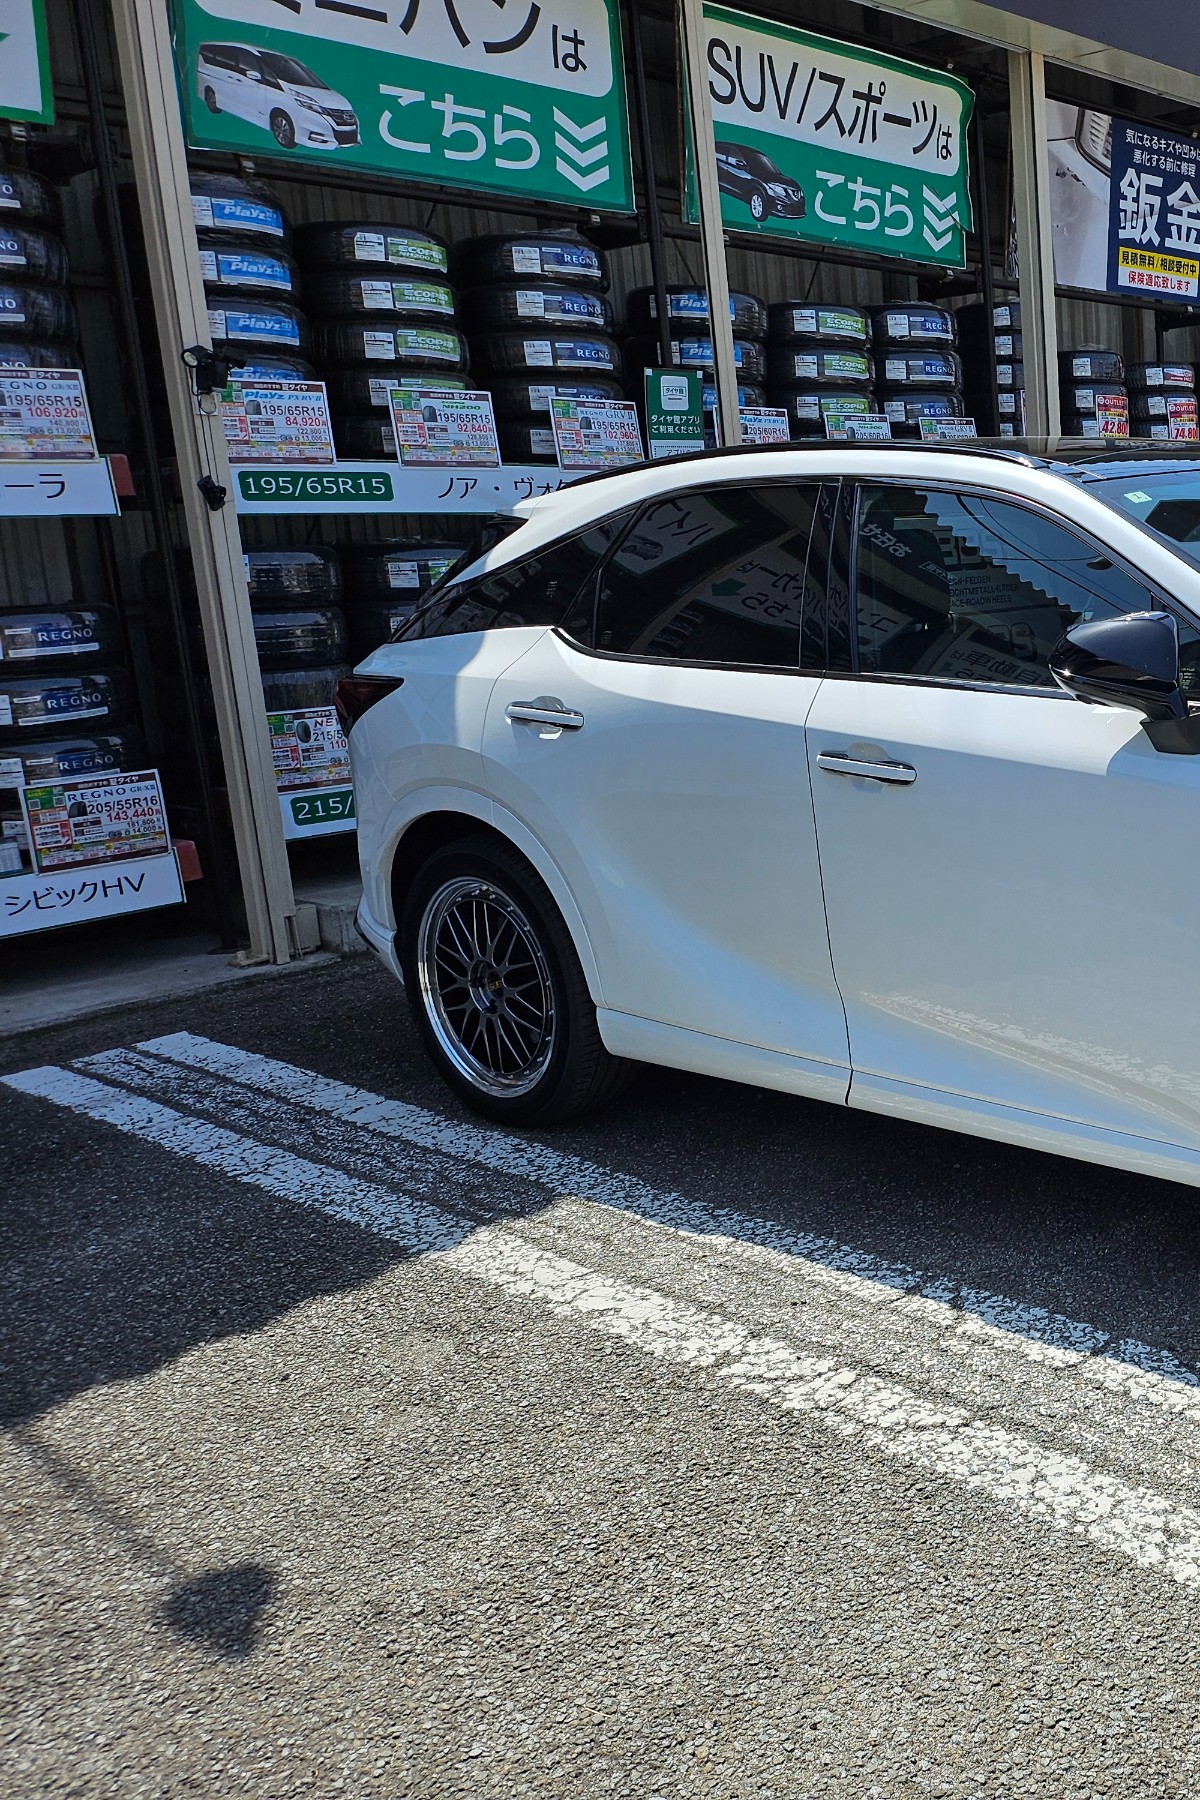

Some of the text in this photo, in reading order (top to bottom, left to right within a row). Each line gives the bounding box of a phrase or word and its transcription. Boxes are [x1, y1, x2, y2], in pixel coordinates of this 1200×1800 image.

[707, 37, 953, 161] SUV/スポーツは
[378, 83, 541, 170] こちら
[1133, 148, 1197, 178] 悪化する前に修理
[814, 169, 914, 237] こちら
[563, 253, 598, 266] REGNO
[1121, 250, 1197, 277] 見積無料/相談受付中
[1128, 270, 1191, 292] 保険適応致します
[565, 302, 601, 315] REGNO
[577, 349, 610, 360] REGNO
[7, 394, 82, 407] 195/65R15
[262, 404, 324, 417] 195/65R15
[437, 412, 491, 424] 195/65R15
[651, 414, 700, 425] タイヤ館アプリ
[651, 424, 701, 434] ご利用ください
[245, 476, 386, 497] 195/65R15
[38, 628, 93, 642] REGNO
[47, 693, 102, 709] REGNO
[59, 754, 114, 770] REGNO
[67, 787, 126, 802] REGNO
[87, 795, 158, 815] 205/55R16
[5, 872, 146, 916] シビックHV
